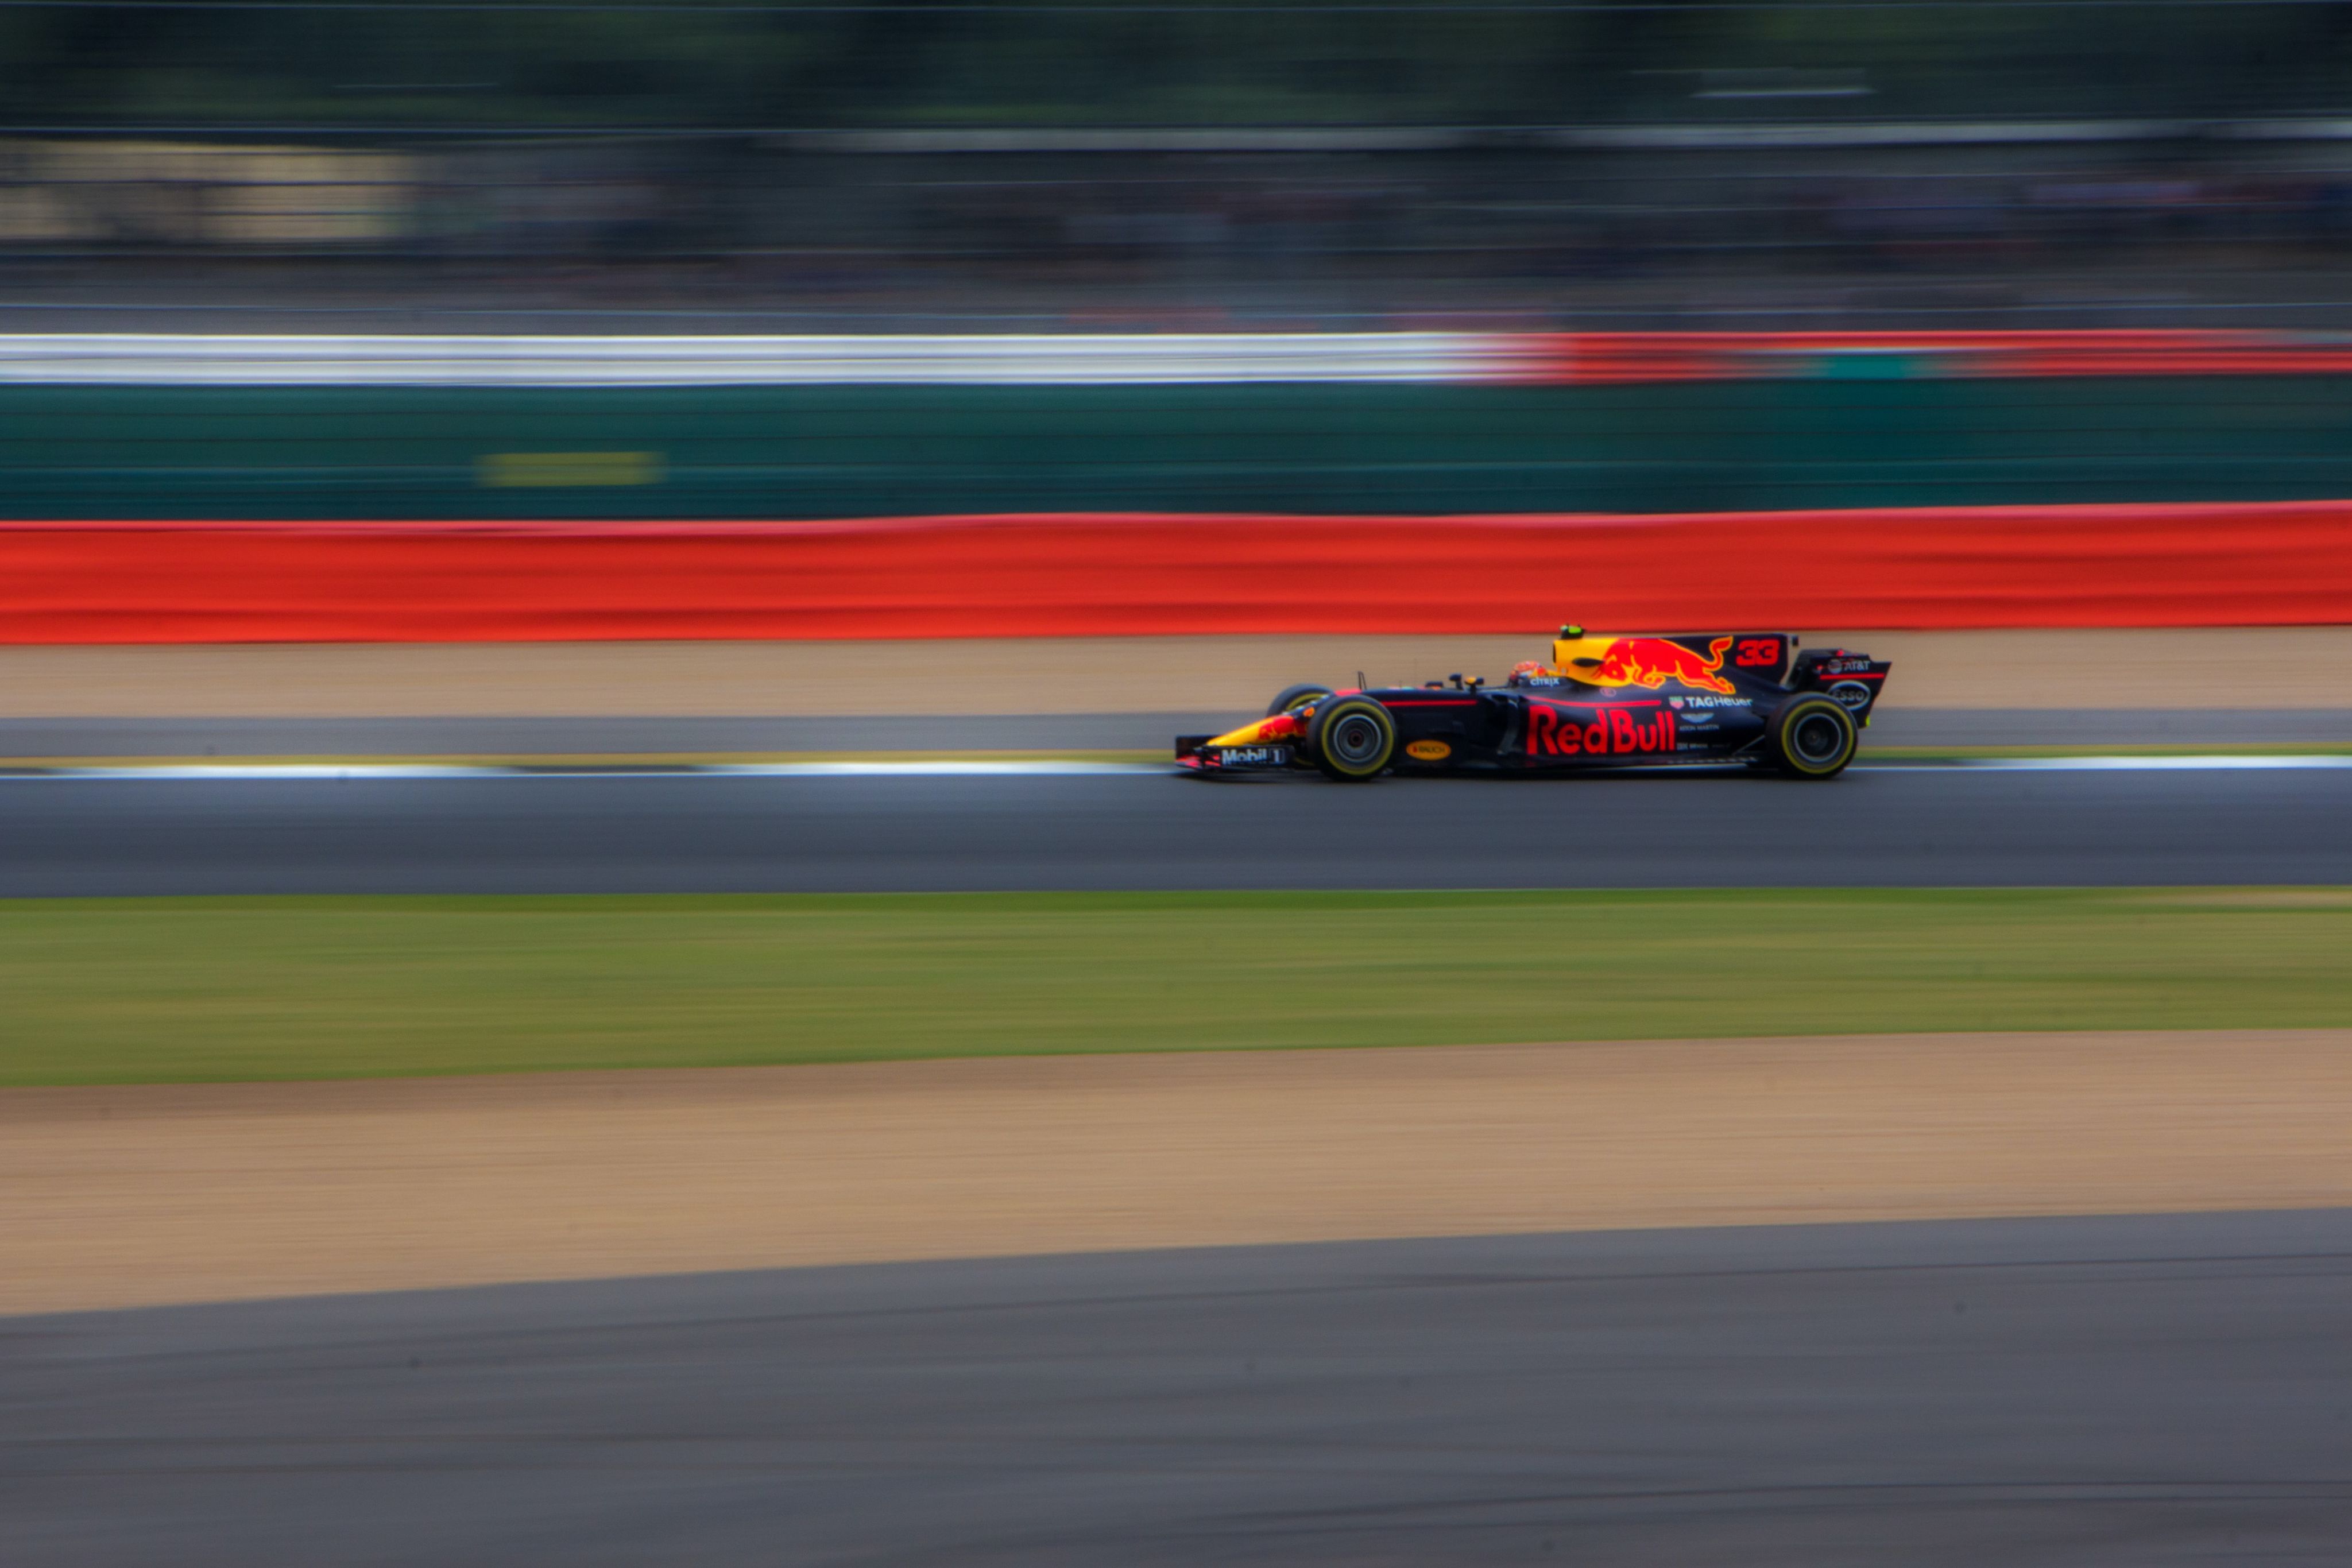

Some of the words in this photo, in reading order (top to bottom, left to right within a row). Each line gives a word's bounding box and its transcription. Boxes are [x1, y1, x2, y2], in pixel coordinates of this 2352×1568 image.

[1736, 639, 1780, 665] 33
[1844, 661, 1870, 671] AT&T
[1222, 748, 1267, 765] Mobil
